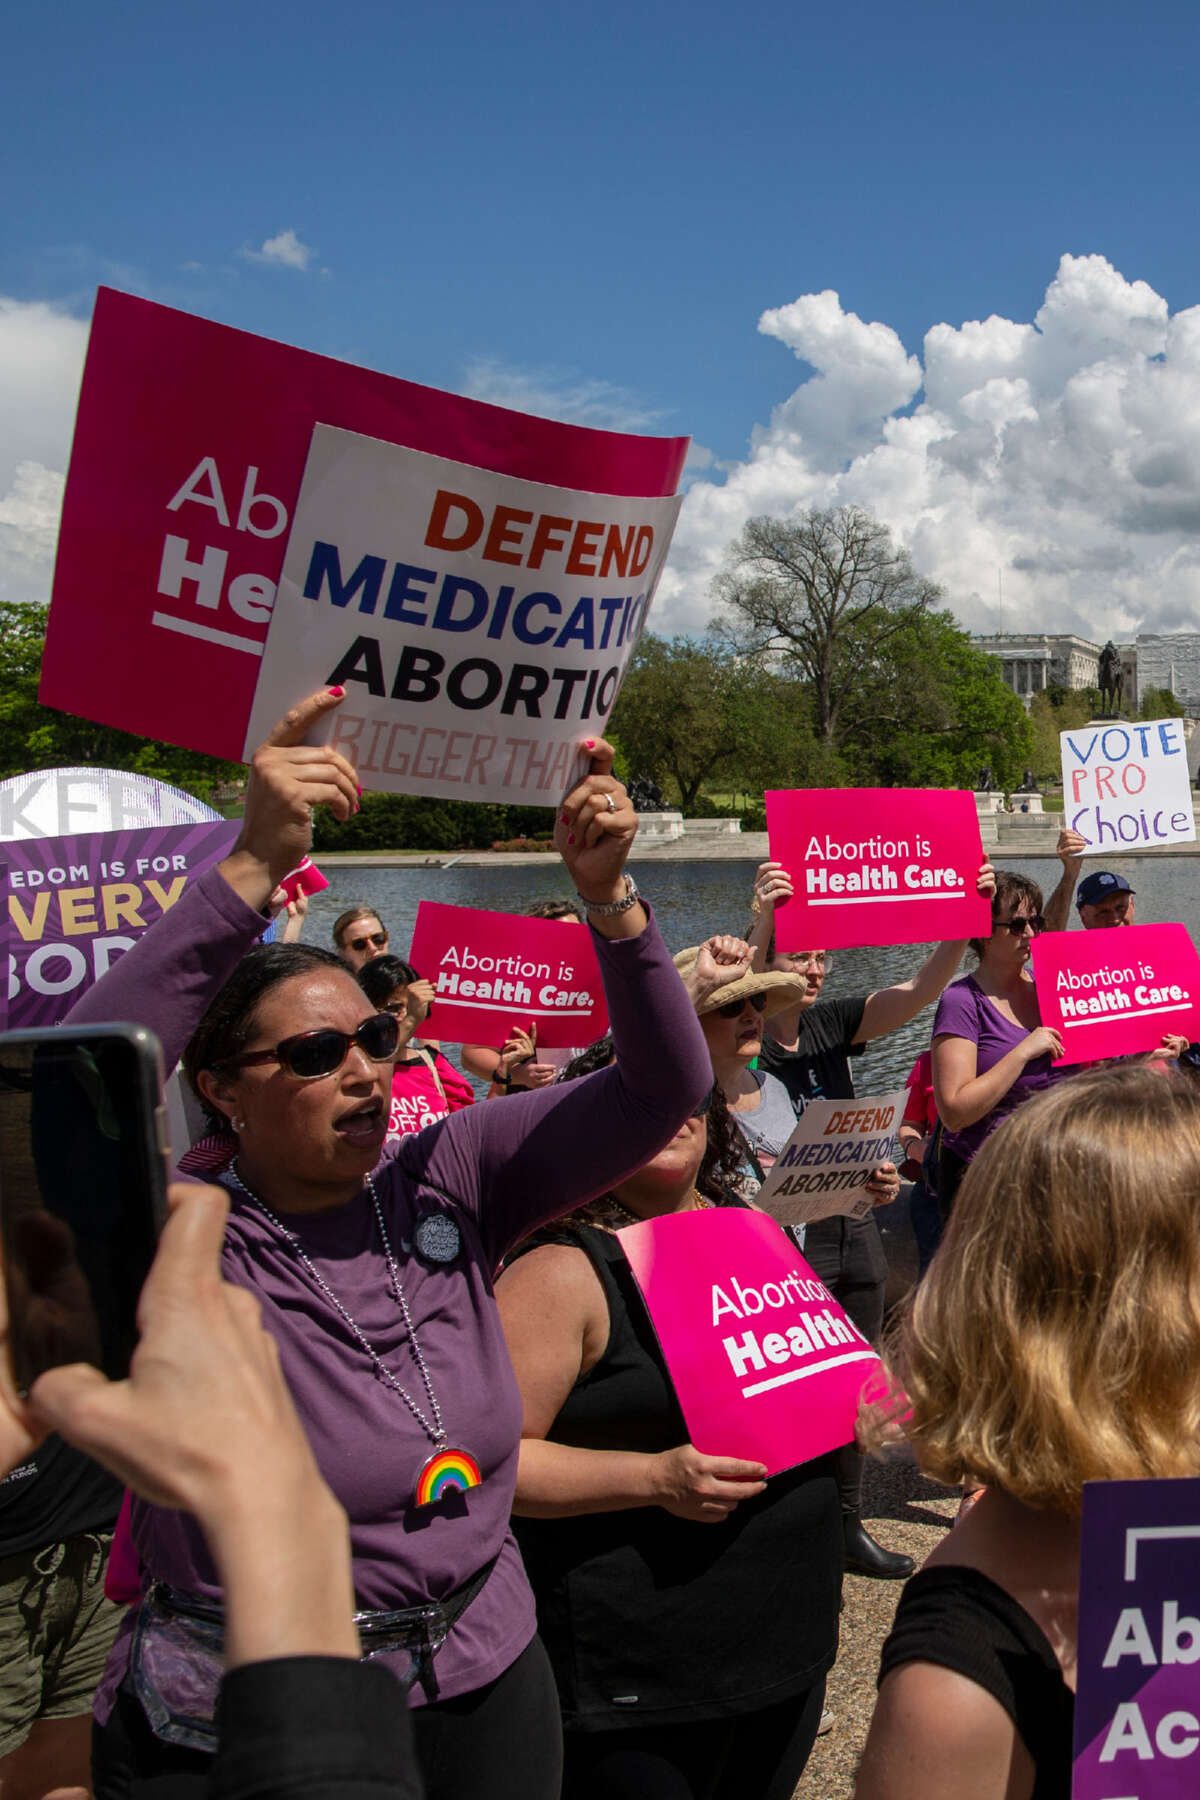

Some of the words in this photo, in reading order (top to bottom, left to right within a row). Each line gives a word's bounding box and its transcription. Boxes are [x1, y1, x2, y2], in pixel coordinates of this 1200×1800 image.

[166, 456, 288, 539] Ab
[424, 489, 654, 578] DEFEND
[157, 533, 278, 623] He
[325, 635, 619, 720] ABORTIO
[331, 715, 498, 786] BIGGER
[1066, 722, 1181, 765] VOTE
[1072, 763, 1146, 803] PRO
[1072, 806, 1190, 845] Choice
[804, 835, 909, 861] Abortion
[916, 834, 932, 857] is
[10, 865, 89, 888] EDOM
[101, 860, 126, 878] IS
[136, 855, 187, 875] FOR
[806, 864, 898, 893] Health
[903, 864, 965, 889] Care.
[440, 946, 551, 979] Abortion
[557, 961, 575, 981] is
[1056, 966, 1136, 991] Abortion
[1138, 961, 1154, 980] is
[436, 972, 532, 1004] Health
[538, 985, 595, 1007] Care.
[1059, 988, 1132, 1017] Health
[1134, 985, 1190, 1006] Care.
[824, 1106, 895, 1136] DEFEND
[780, 1136, 896, 1168] MEDICATION
[712, 1270, 836, 1327] Abortion
[722, 1309, 856, 1378] Health
